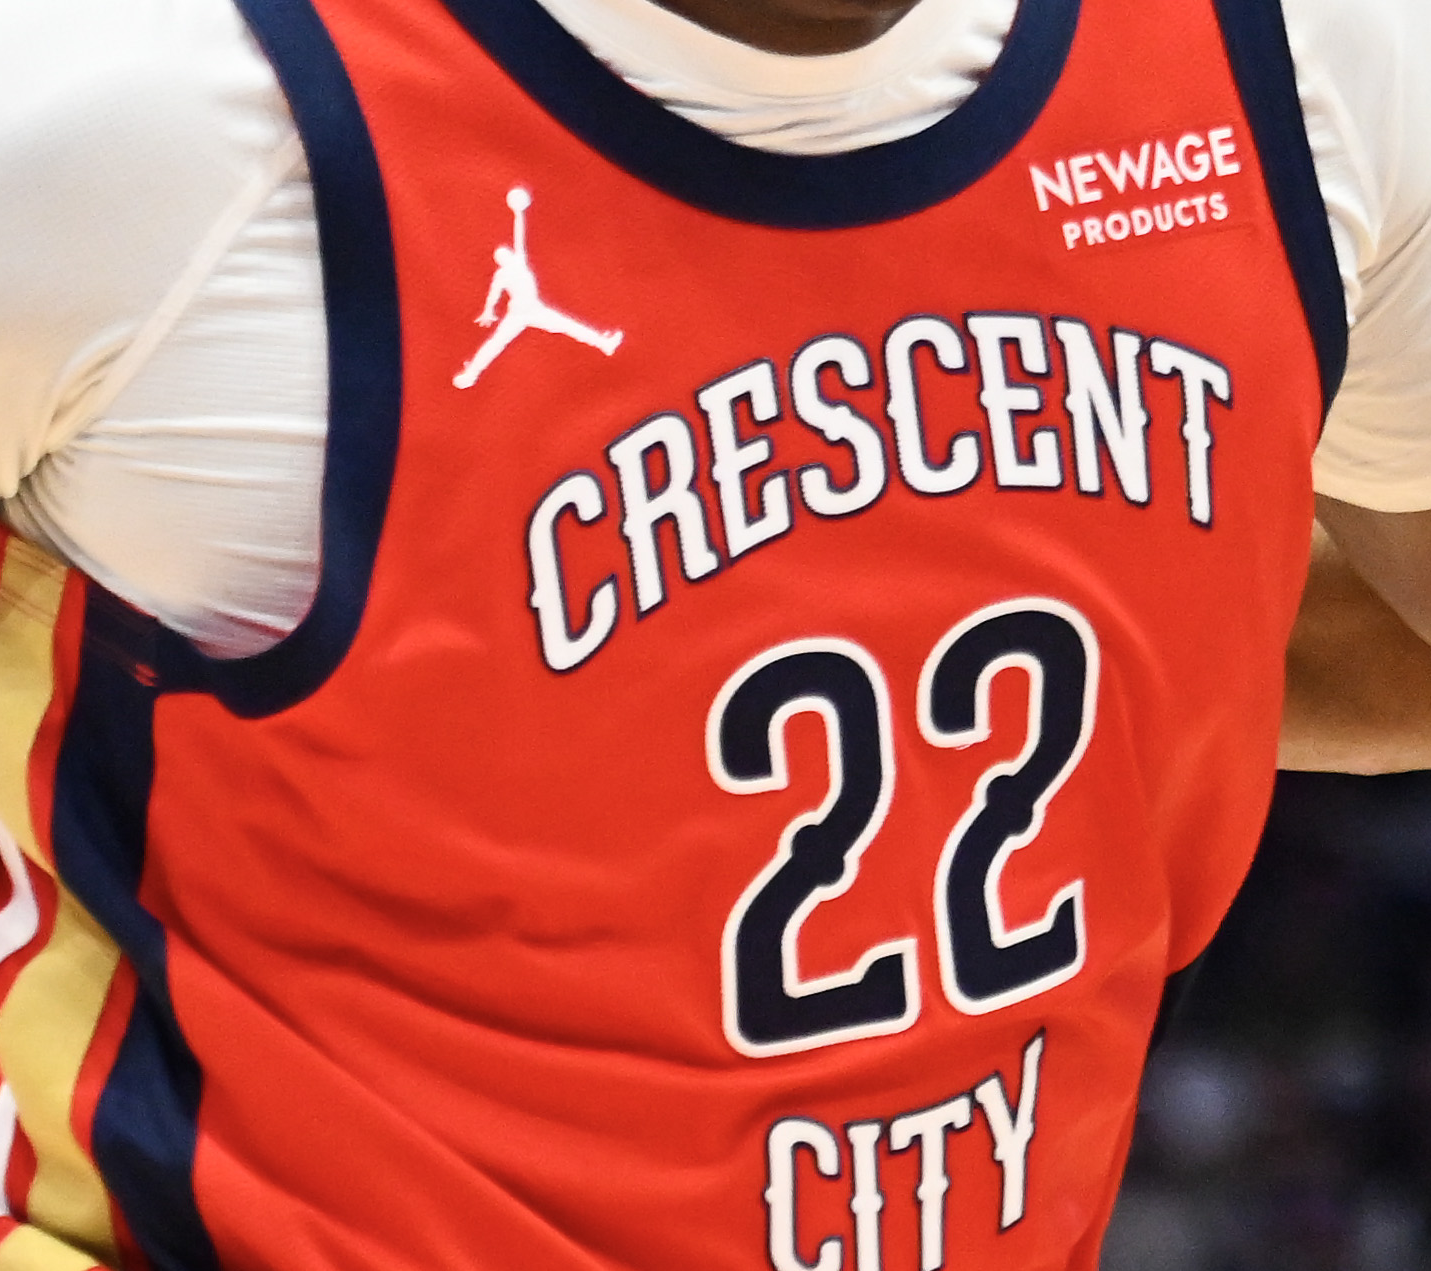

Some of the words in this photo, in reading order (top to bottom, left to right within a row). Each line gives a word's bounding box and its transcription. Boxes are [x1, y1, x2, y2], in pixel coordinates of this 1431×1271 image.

[1028, 126, 1242, 212] NEWAGE
[1061, 191, 1230, 251] PRODUCTS
[524, 310, 1233, 676] CRESCENT
[704, 595, 1101, 1059] 22
